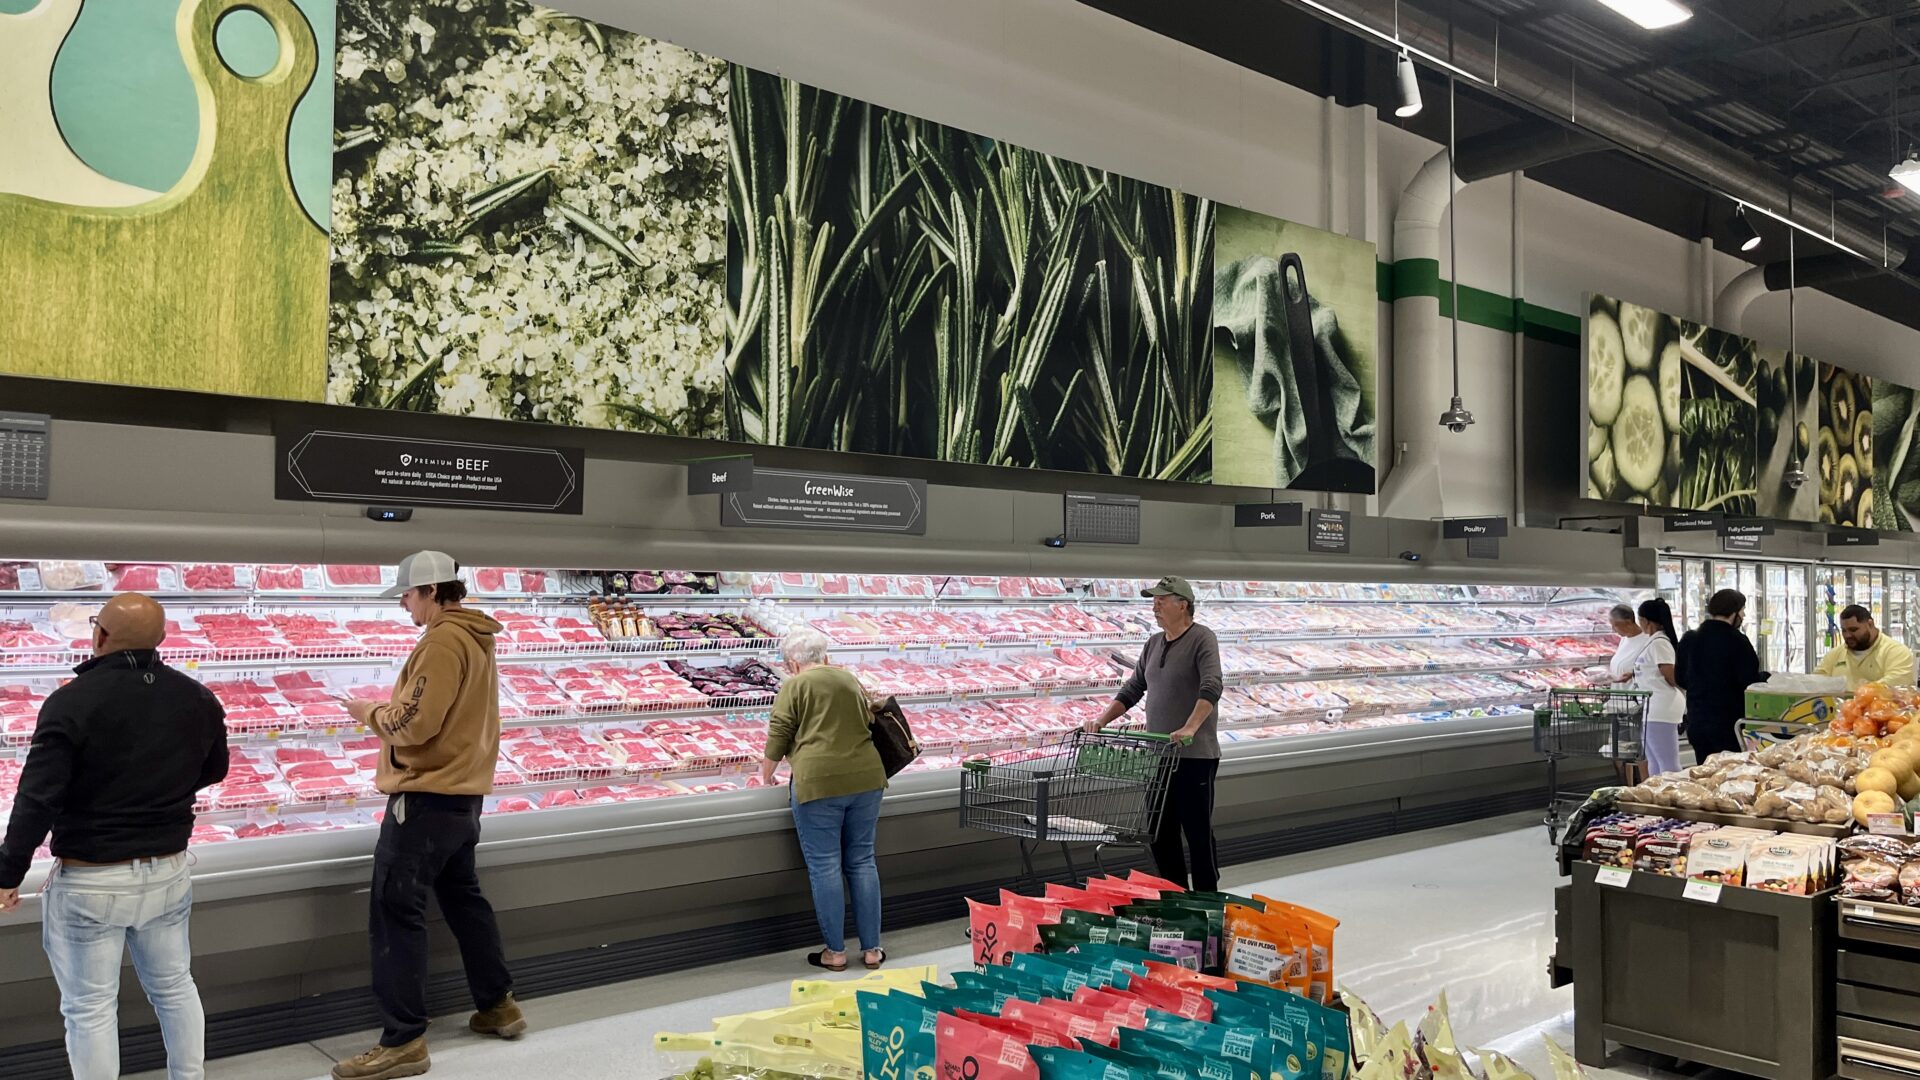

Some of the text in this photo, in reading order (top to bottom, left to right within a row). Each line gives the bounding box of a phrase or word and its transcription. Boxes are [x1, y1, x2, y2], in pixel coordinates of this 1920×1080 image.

[415, 458, 452, 466] PREMIUM
[456, 458, 490, 471] BEEF
[711, 472, 728, 483] Beef
[804, 480, 854, 497] GreenWise
[1260, 512, 1276, 520] Pork
[1463, 525, 1487, 534] Poultry
[1237, 937, 1247, 945] THE
[1258, 942, 1277, 951] PLEDGE
[1224, 1044, 1251, 1058] TASTE
[1002, 1052, 1024, 1066] TASTE
